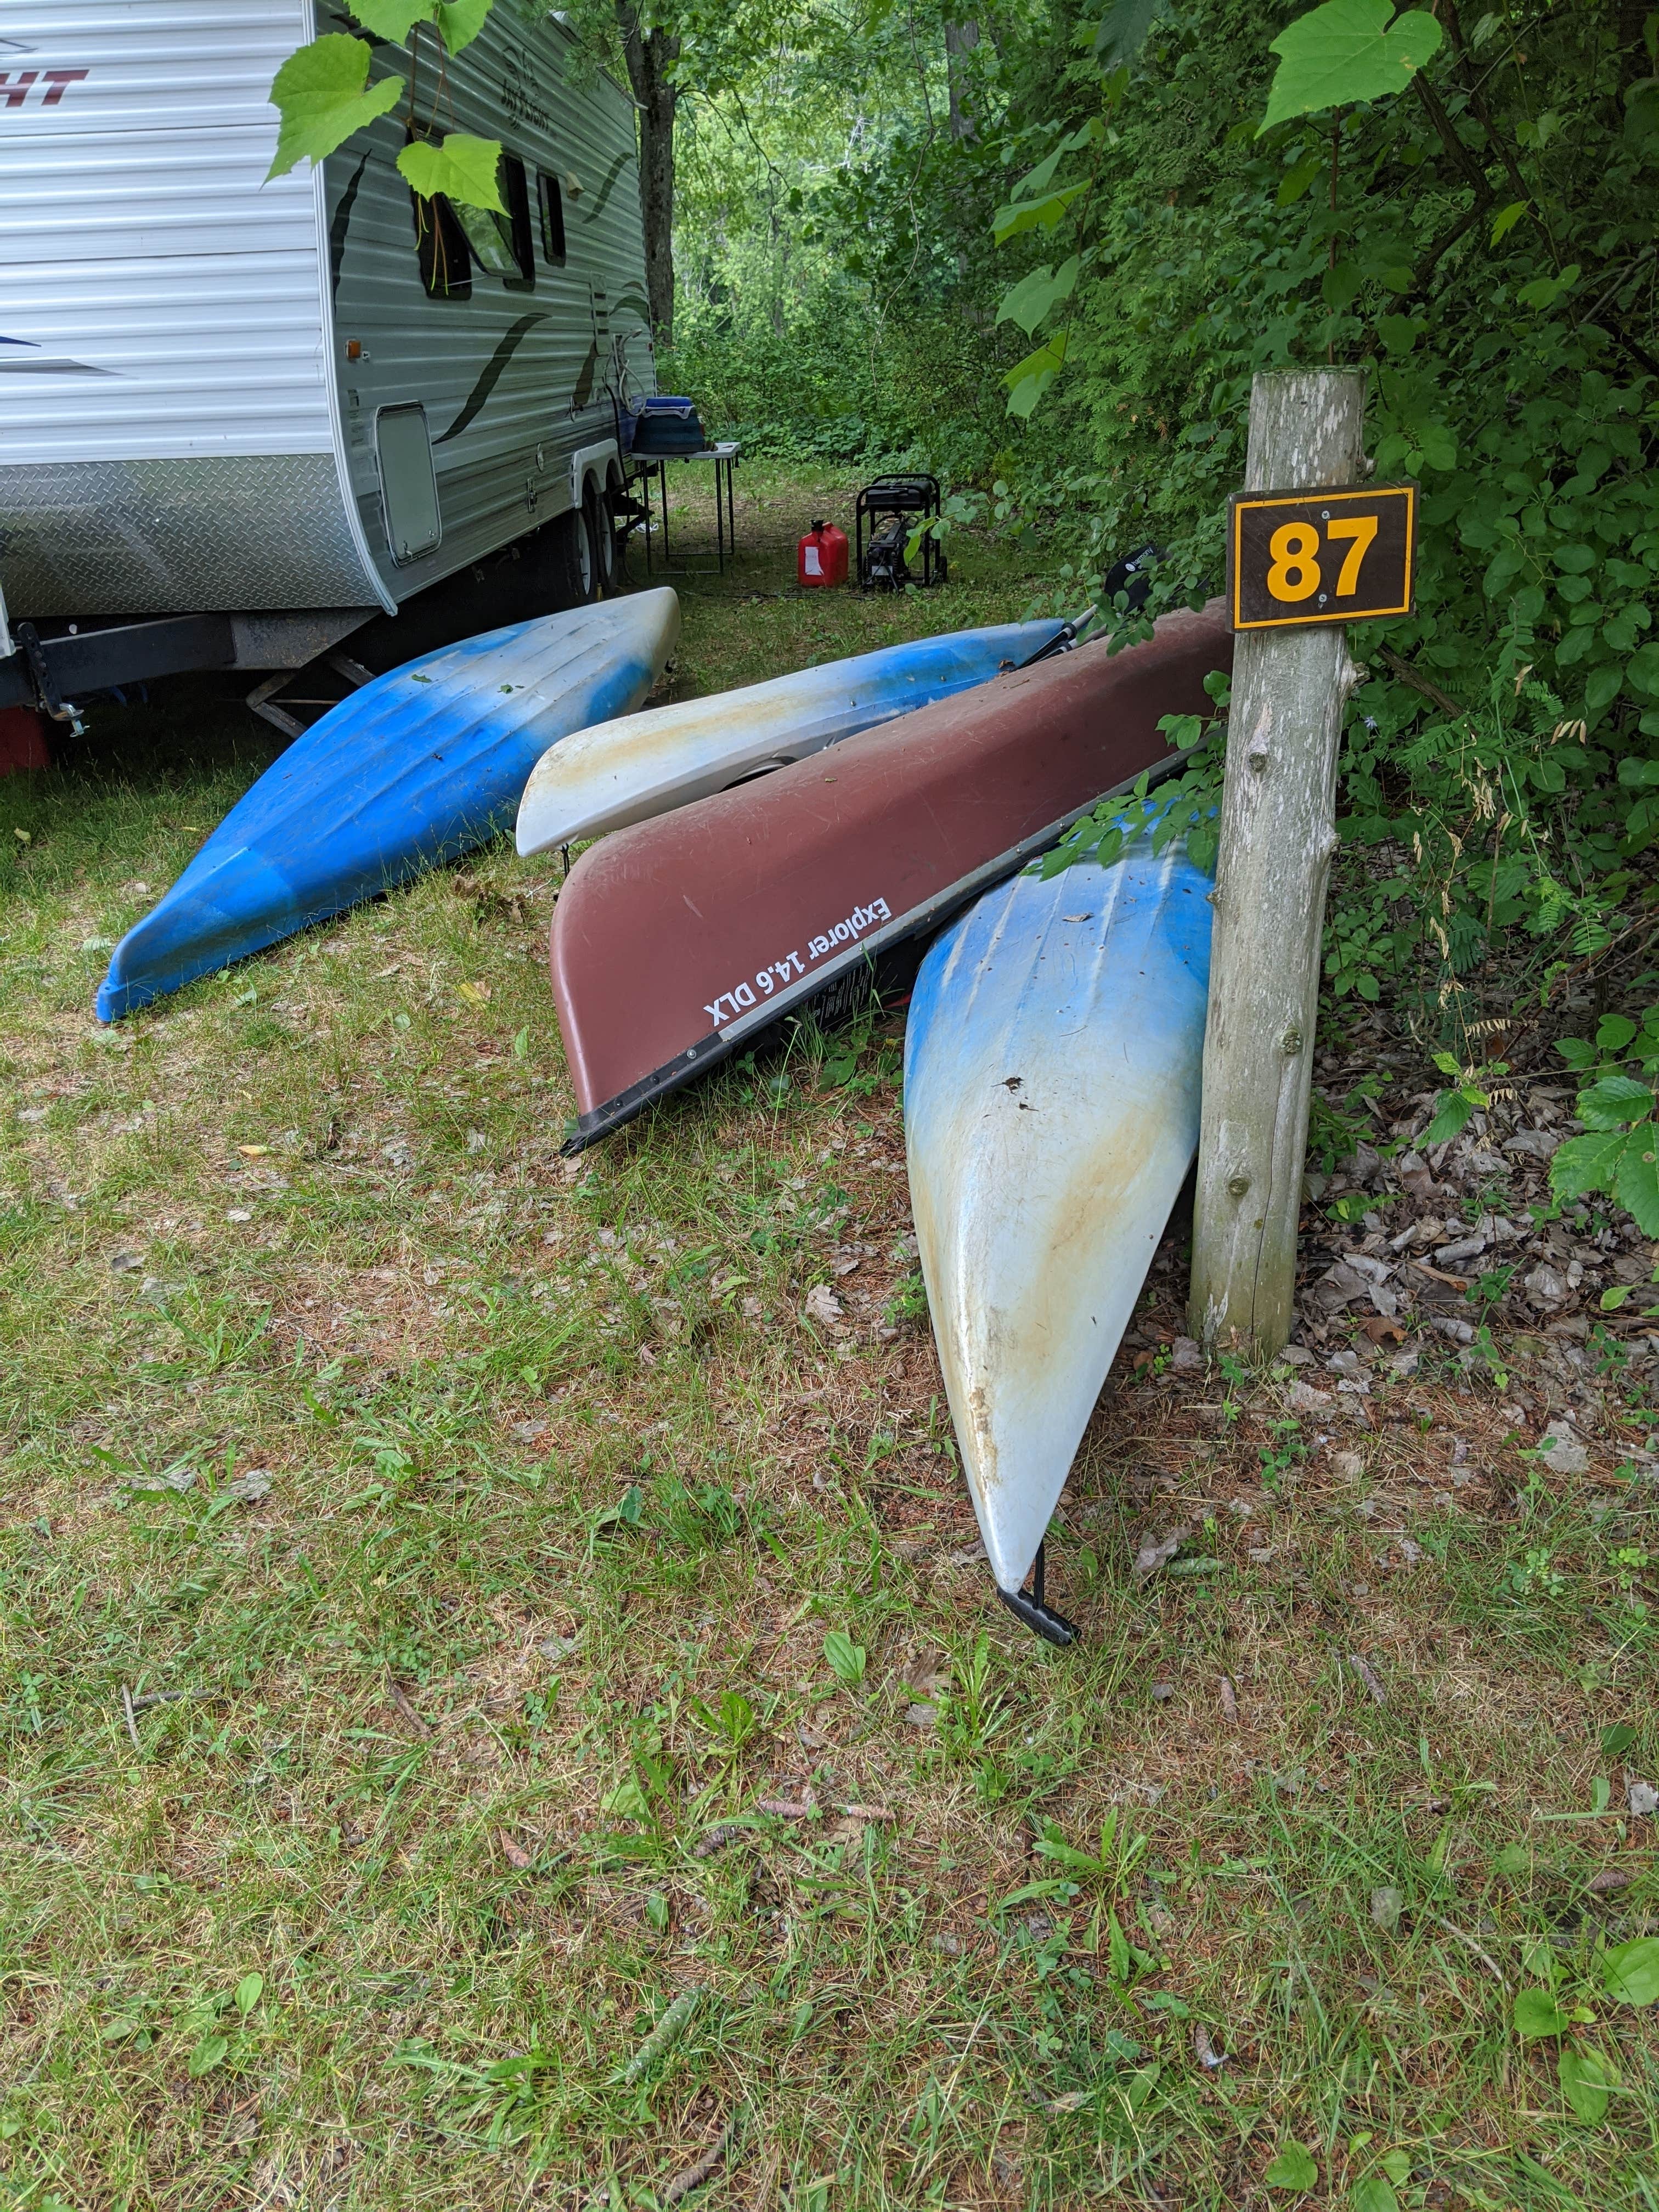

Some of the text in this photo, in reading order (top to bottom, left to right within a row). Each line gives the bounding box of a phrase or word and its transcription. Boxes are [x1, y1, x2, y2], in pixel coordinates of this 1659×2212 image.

[1131, 546, 1154, 566] harmony
[1267, 515, 1378, 602] 87
[808, 897, 892, 960] Explorer
[755, 950, 805, 995] 14.6
[703, 981, 757, 1027] DLX
